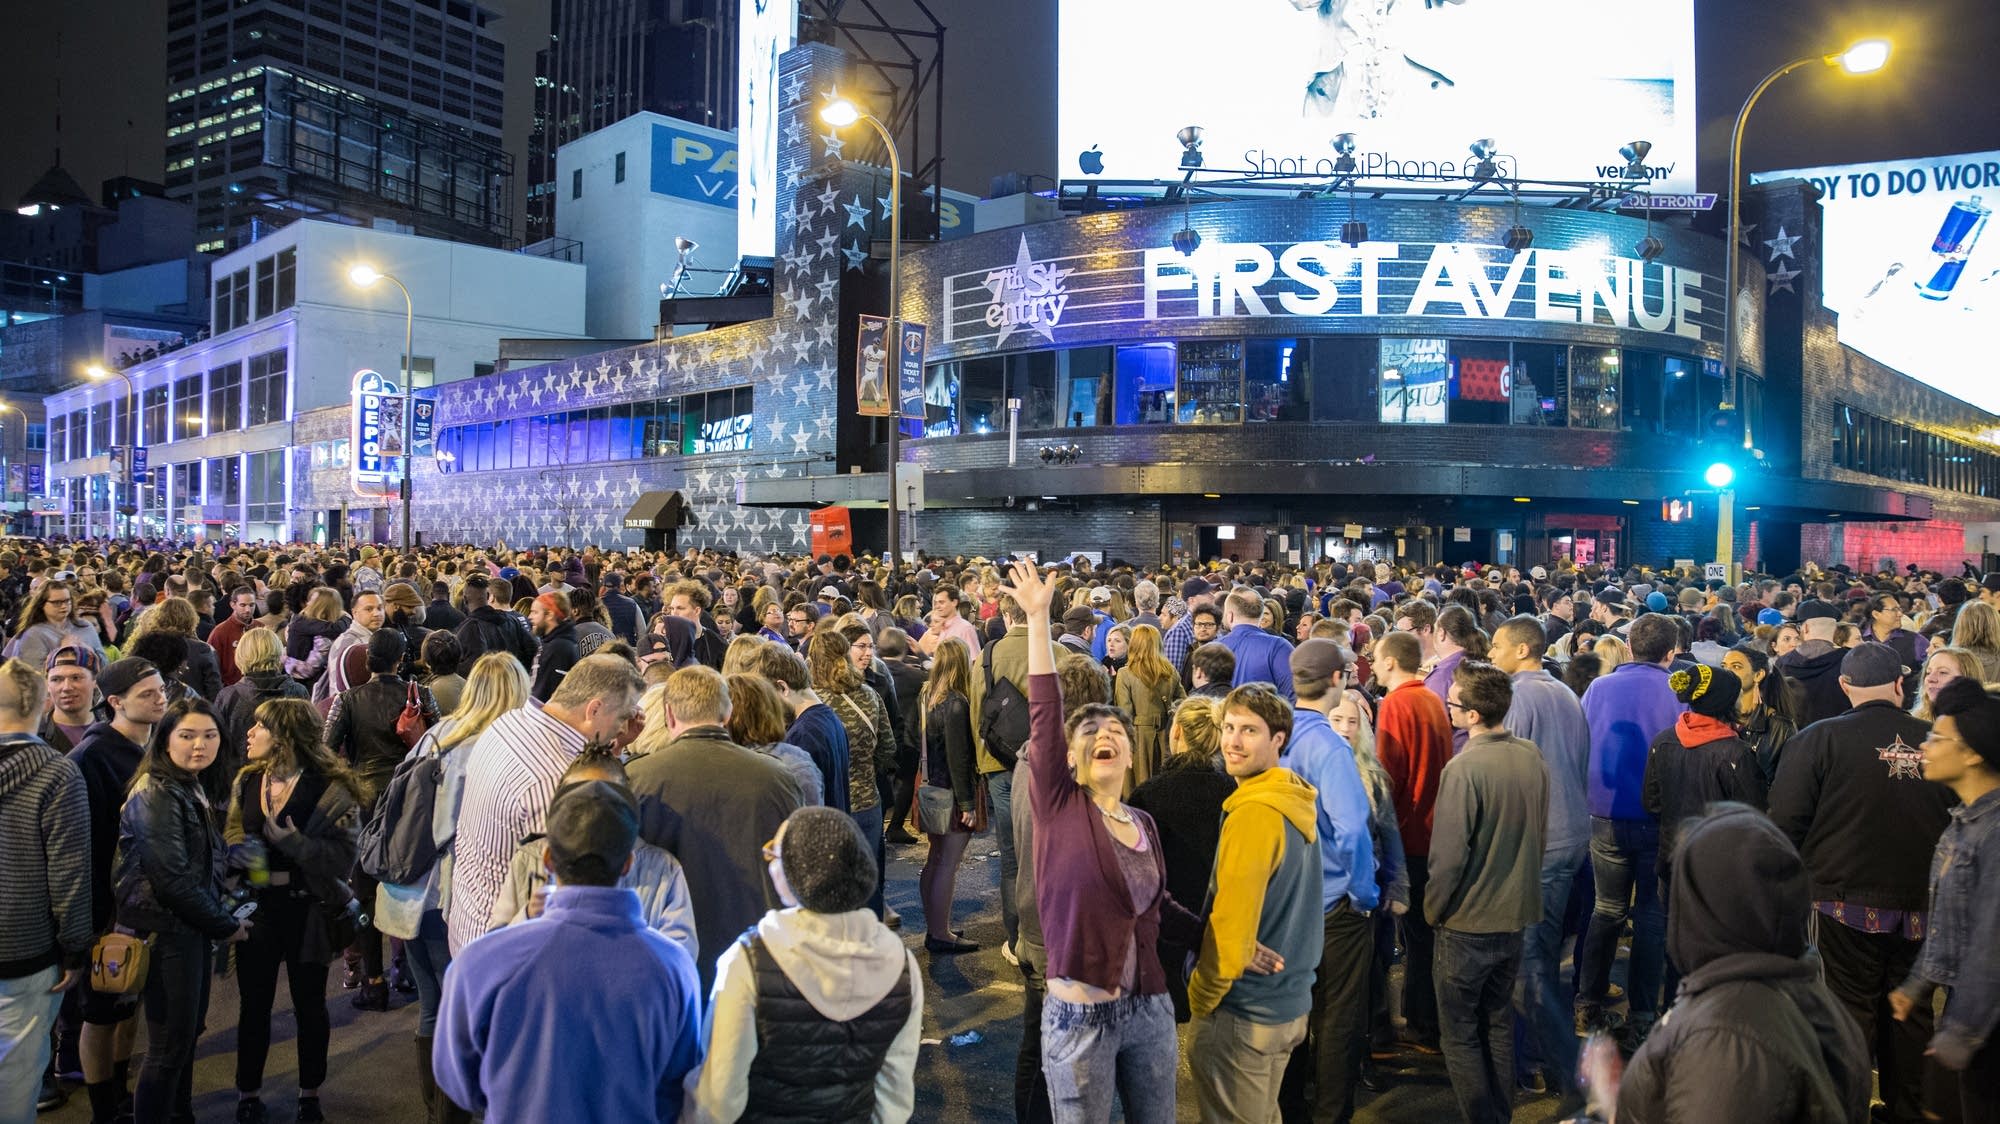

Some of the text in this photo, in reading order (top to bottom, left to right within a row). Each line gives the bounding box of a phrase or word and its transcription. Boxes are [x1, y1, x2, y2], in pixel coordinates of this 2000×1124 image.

[1244, 149, 1307, 177] Shot
[1360, 152, 1455, 181] iPhone
[1596, 164, 1668, 180] veron
[1848, 172, 1881, 198] TO
[1888, 168, 1927, 195] DO
[1933, 162, 2000, 191] WOR
[1629, 194, 1706, 208] OUTFRONT
[983, 263, 1075, 304] 7th St
[1144, 241, 1702, 341] FIRST AVENUE
[985, 291, 1069, 328] entry
[363, 395, 380, 470] DEPOT
[1707, 566, 1725, 577] ONE
